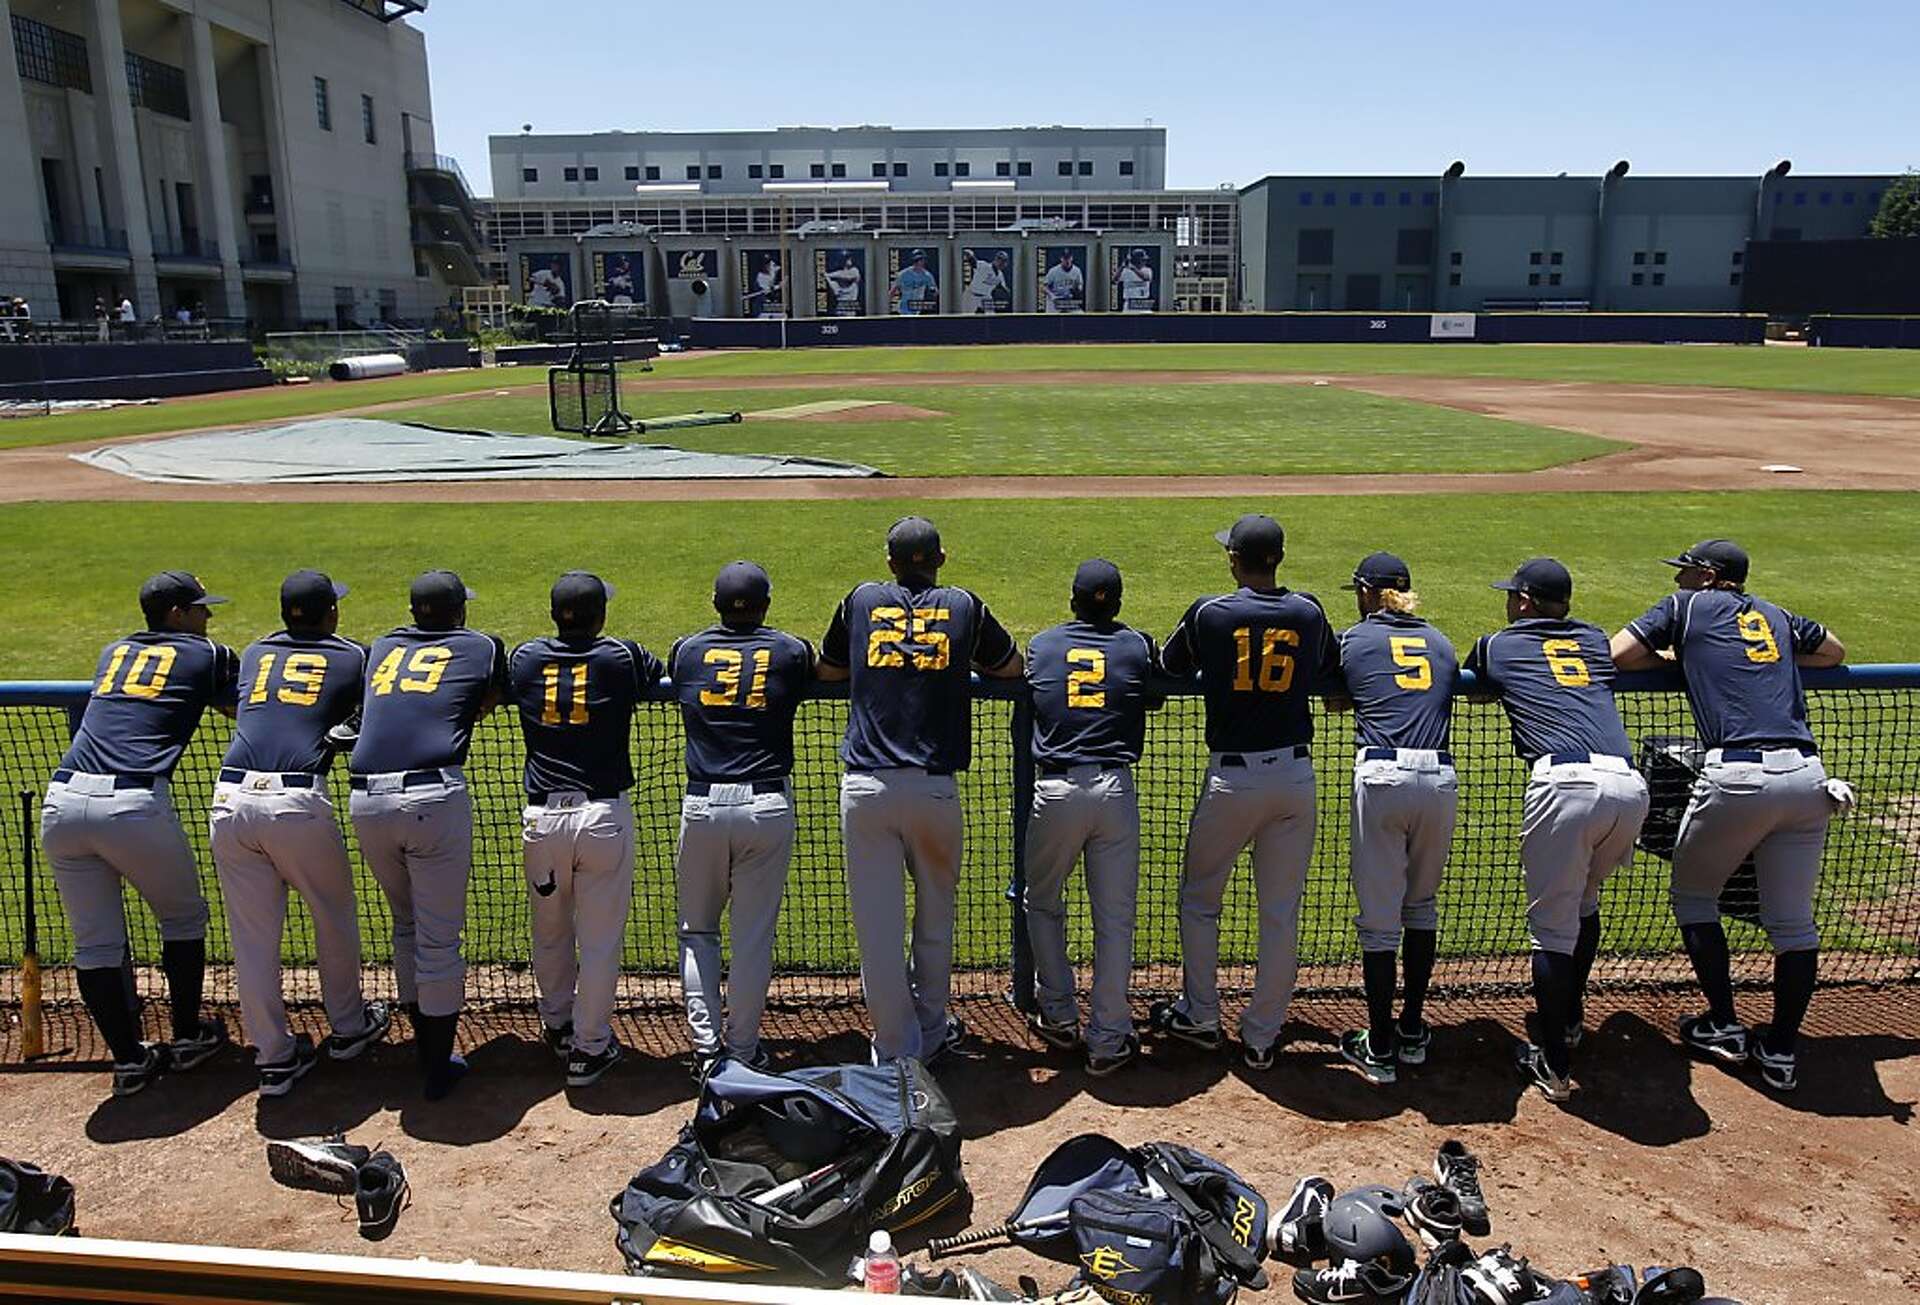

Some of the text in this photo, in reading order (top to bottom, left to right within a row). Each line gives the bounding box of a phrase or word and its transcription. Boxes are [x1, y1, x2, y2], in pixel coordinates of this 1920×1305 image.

[680, 250, 704, 271] Cal
[868, 607, 949, 670] 25
[1234, 628, 1298, 691] 16
[1388, 637, 1433, 691] 5
[1543, 639, 1591, 686] 6
[1738, 611, 1780, 662] 9
[97, 645, 178, 699] 10
[541, 663, 589, 724] 11
[700, 648, 771, 708] 31
[1066, 648, 1106, 708] 2
